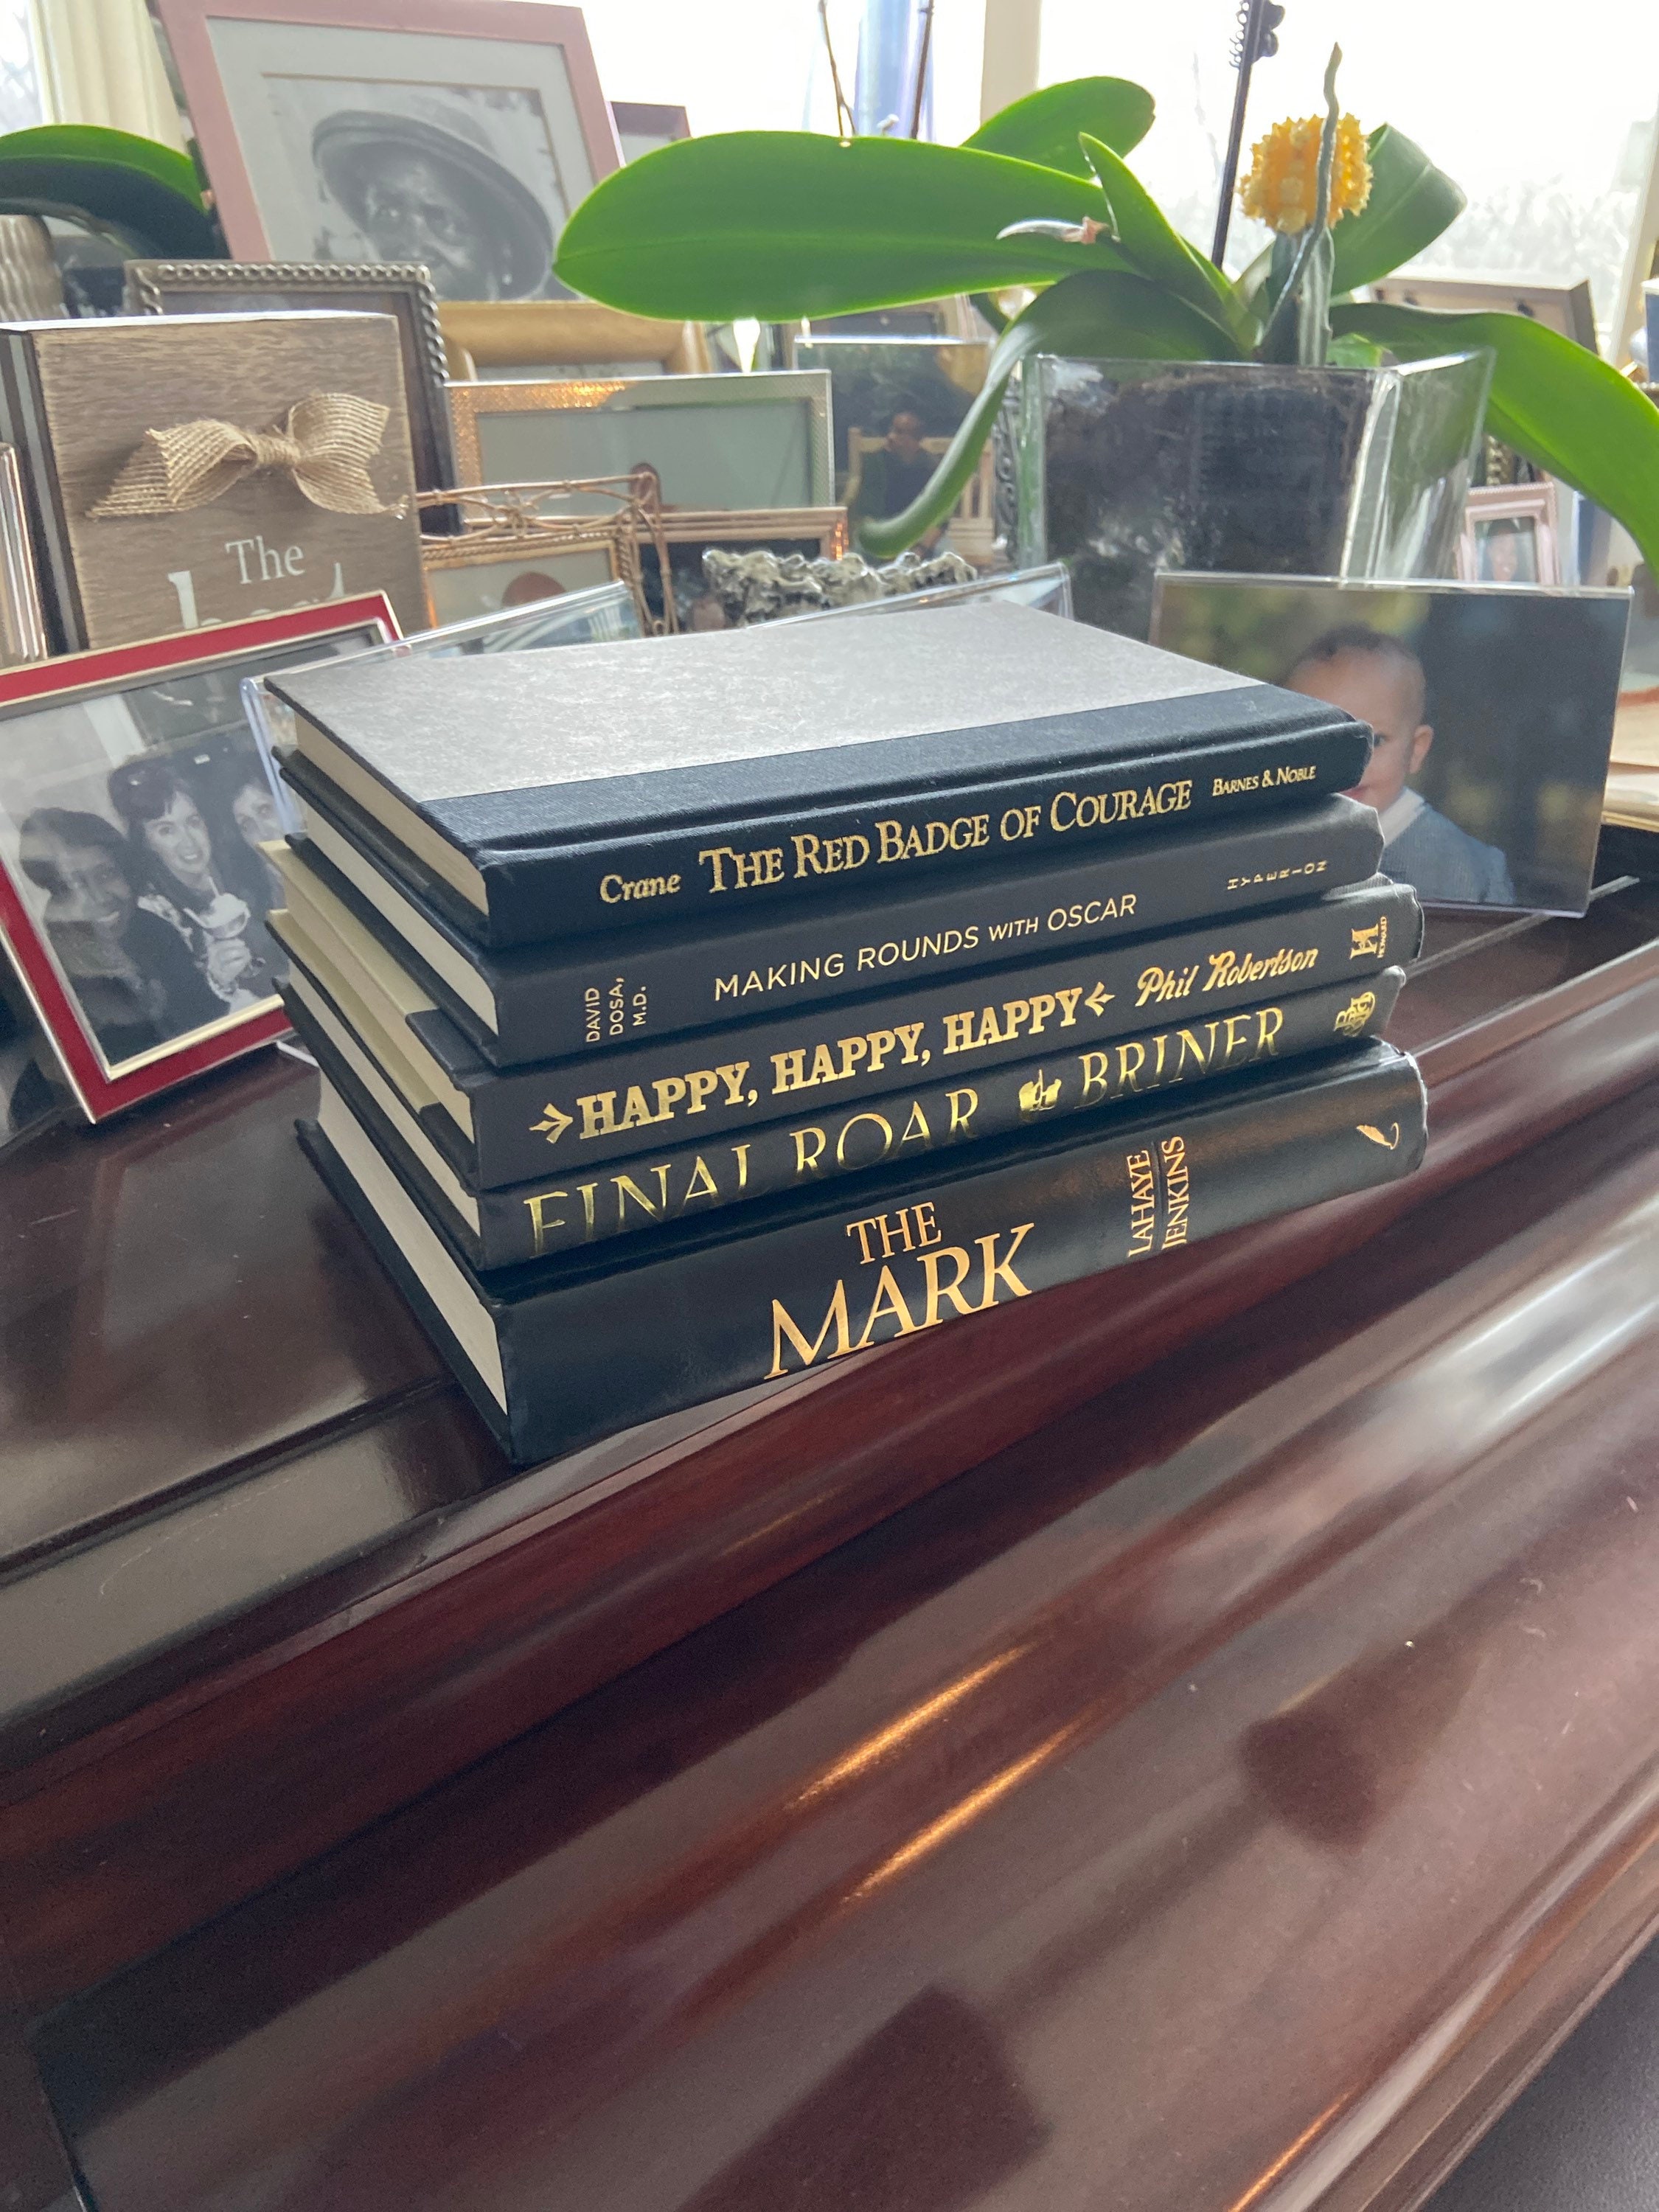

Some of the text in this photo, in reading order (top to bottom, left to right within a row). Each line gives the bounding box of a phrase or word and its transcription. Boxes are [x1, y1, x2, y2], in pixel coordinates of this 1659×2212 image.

[224, 535, 306, 585] The
[1211, 765, 1318, 797] BARNES & NOBLE
[599, 779, 1194, 904] Crane THE RED BADGE OF COURAGE
[713, 892, 1138, 1002] MAKING ROUNDS WITH OSCAR
[1134, 946, 1320, 1007] Phil Robertson
[584, 987, 601, 1043] DAVID
[608, 976, 625, 1036] DOSA,
[632, 985, 647, 1026] M.D.
[575, 986, 1083, 1140] HAPPY, HAPPY, HAPPY
[523, 1006, 1284, 1258] FINAL ROAR BRINER
[846, 1201, 942, 1265] THE
[1127, 1149, 1155, 1258] LAHAYE
[1161, 1135, 1190, 1251] JENKINS
[764, 1222, 1035, 1380] MARK
